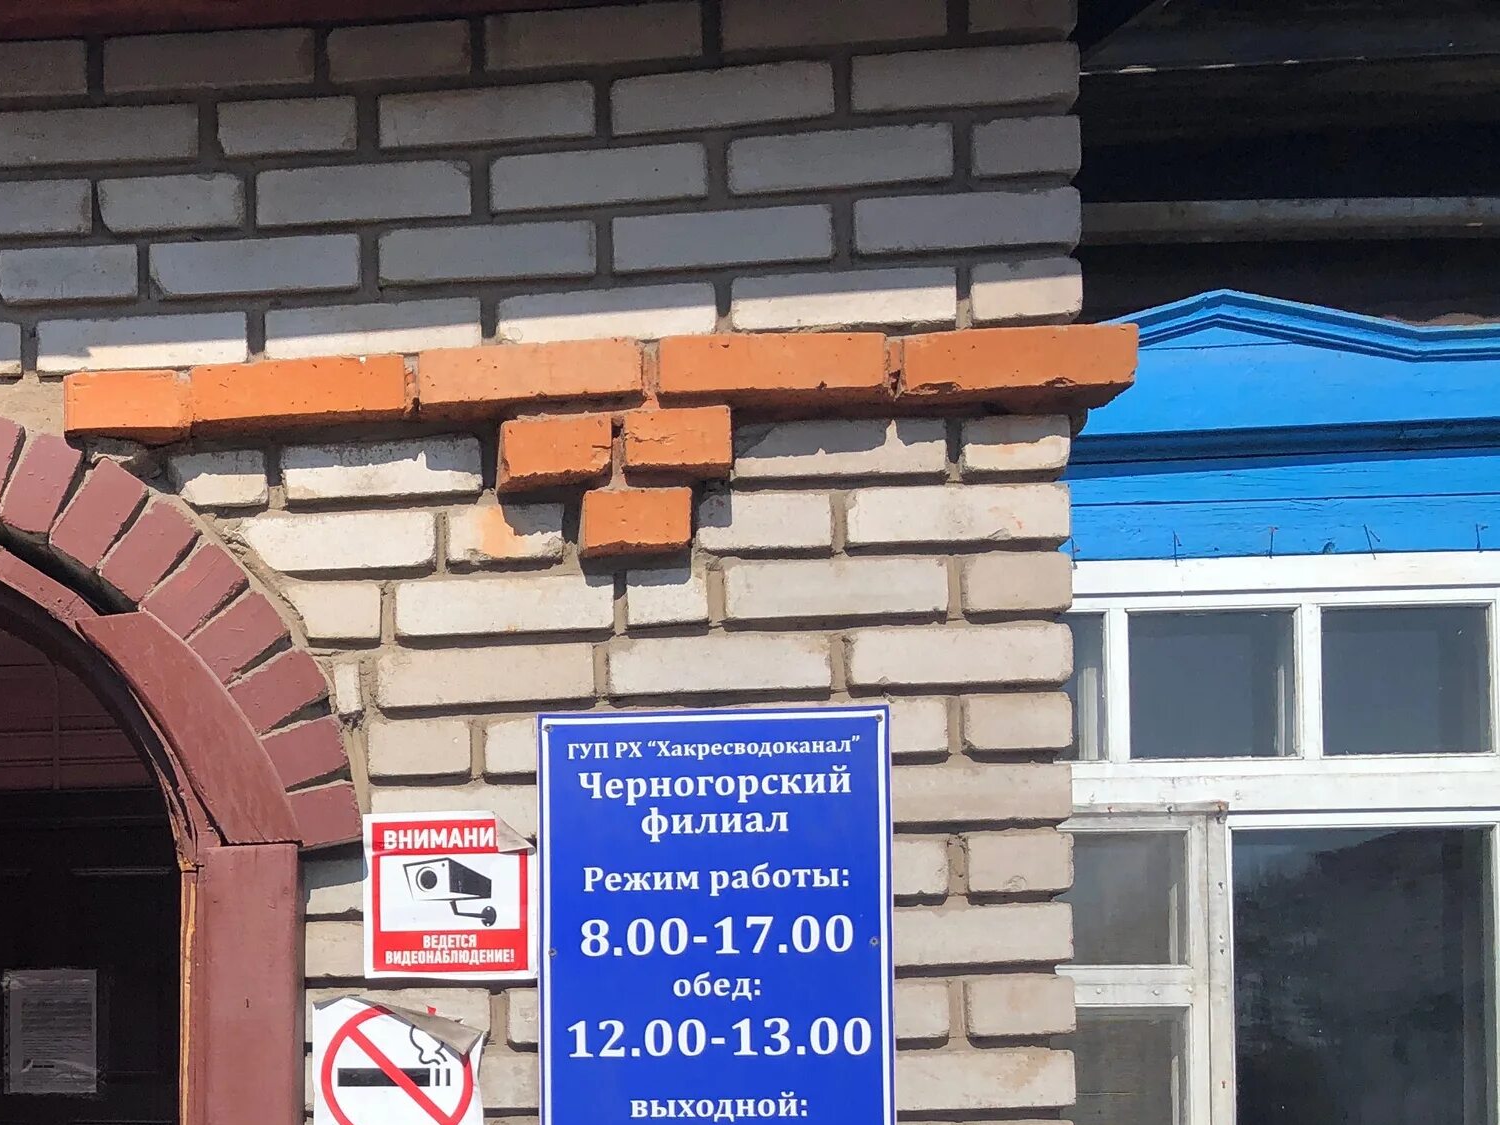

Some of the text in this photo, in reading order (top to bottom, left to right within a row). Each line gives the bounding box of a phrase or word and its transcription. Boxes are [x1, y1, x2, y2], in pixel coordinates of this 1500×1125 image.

[567, 742, 609, 760] ГУП
[615, 741, 642, 758] РХ
[578, 765, 852, 806] Черногорский
[383, 827, 499, 850] ВНИМАНИ
[641, 807, 788, 842] филиал
[583, 862, 849, 896] Режим работы:
[423, 934, 477, 950] ВЕДЕТСЯ
[580, 914, 854, 956] 8.00-17.00
[385, 949, 515, 966] ВИДЕОНАБЛЮДЕНИЕ!
[672, 971, 762, 1001] обед:
[566, 1016, 872, 1058] 12.00-13.00
[630, 1091, 808, 1122] выходной:
